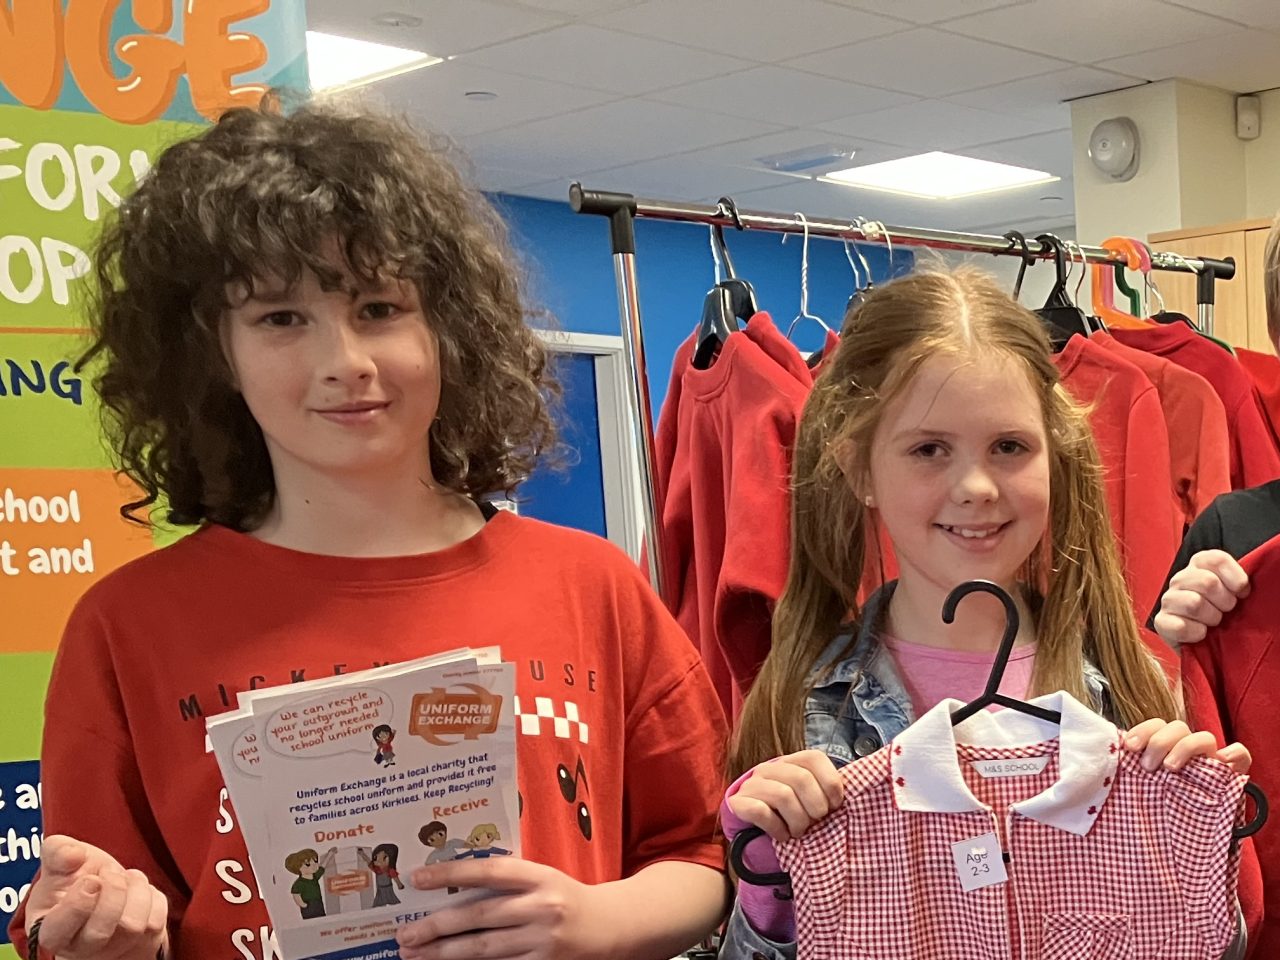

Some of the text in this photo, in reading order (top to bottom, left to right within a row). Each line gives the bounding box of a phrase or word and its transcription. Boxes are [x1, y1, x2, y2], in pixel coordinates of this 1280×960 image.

[0, 488, 80, 523] hool
[28, 538, 94, 574] and
[178, 661, 390, 721] MICKE
[280, 692, 368, 721] We can recycle
[271, 697, 384, 737] your outgrown and
[418, 715, 491, 726] EXCHANGE
[420, 703, 493, 715] UNIFORM
[245, 733, 257, 743] W
[280, 710, 380, 744] no longer needed
[290, 723, 375, 752] school uniform
[237, 746, 258, 760] you
[984, 762, 1040, 774] M&S SCHOOL
[289, 763, 497, 814] recycles school uniform and provides it free
[296, 753, 489, 799] Uniform Exchange is a local charity that
[295, 815, 306, 825] to
[308, 808, 347, 823] families
[350, 803, 379, 815] across
[423, 788, 446, 801] Keep
[449, 776, 495, 794] Recycling!
[314, 797, 490, 844] Donate Receive
[966, 851, 988, 865] Age
[971, 863, 990, 877] 2-3
